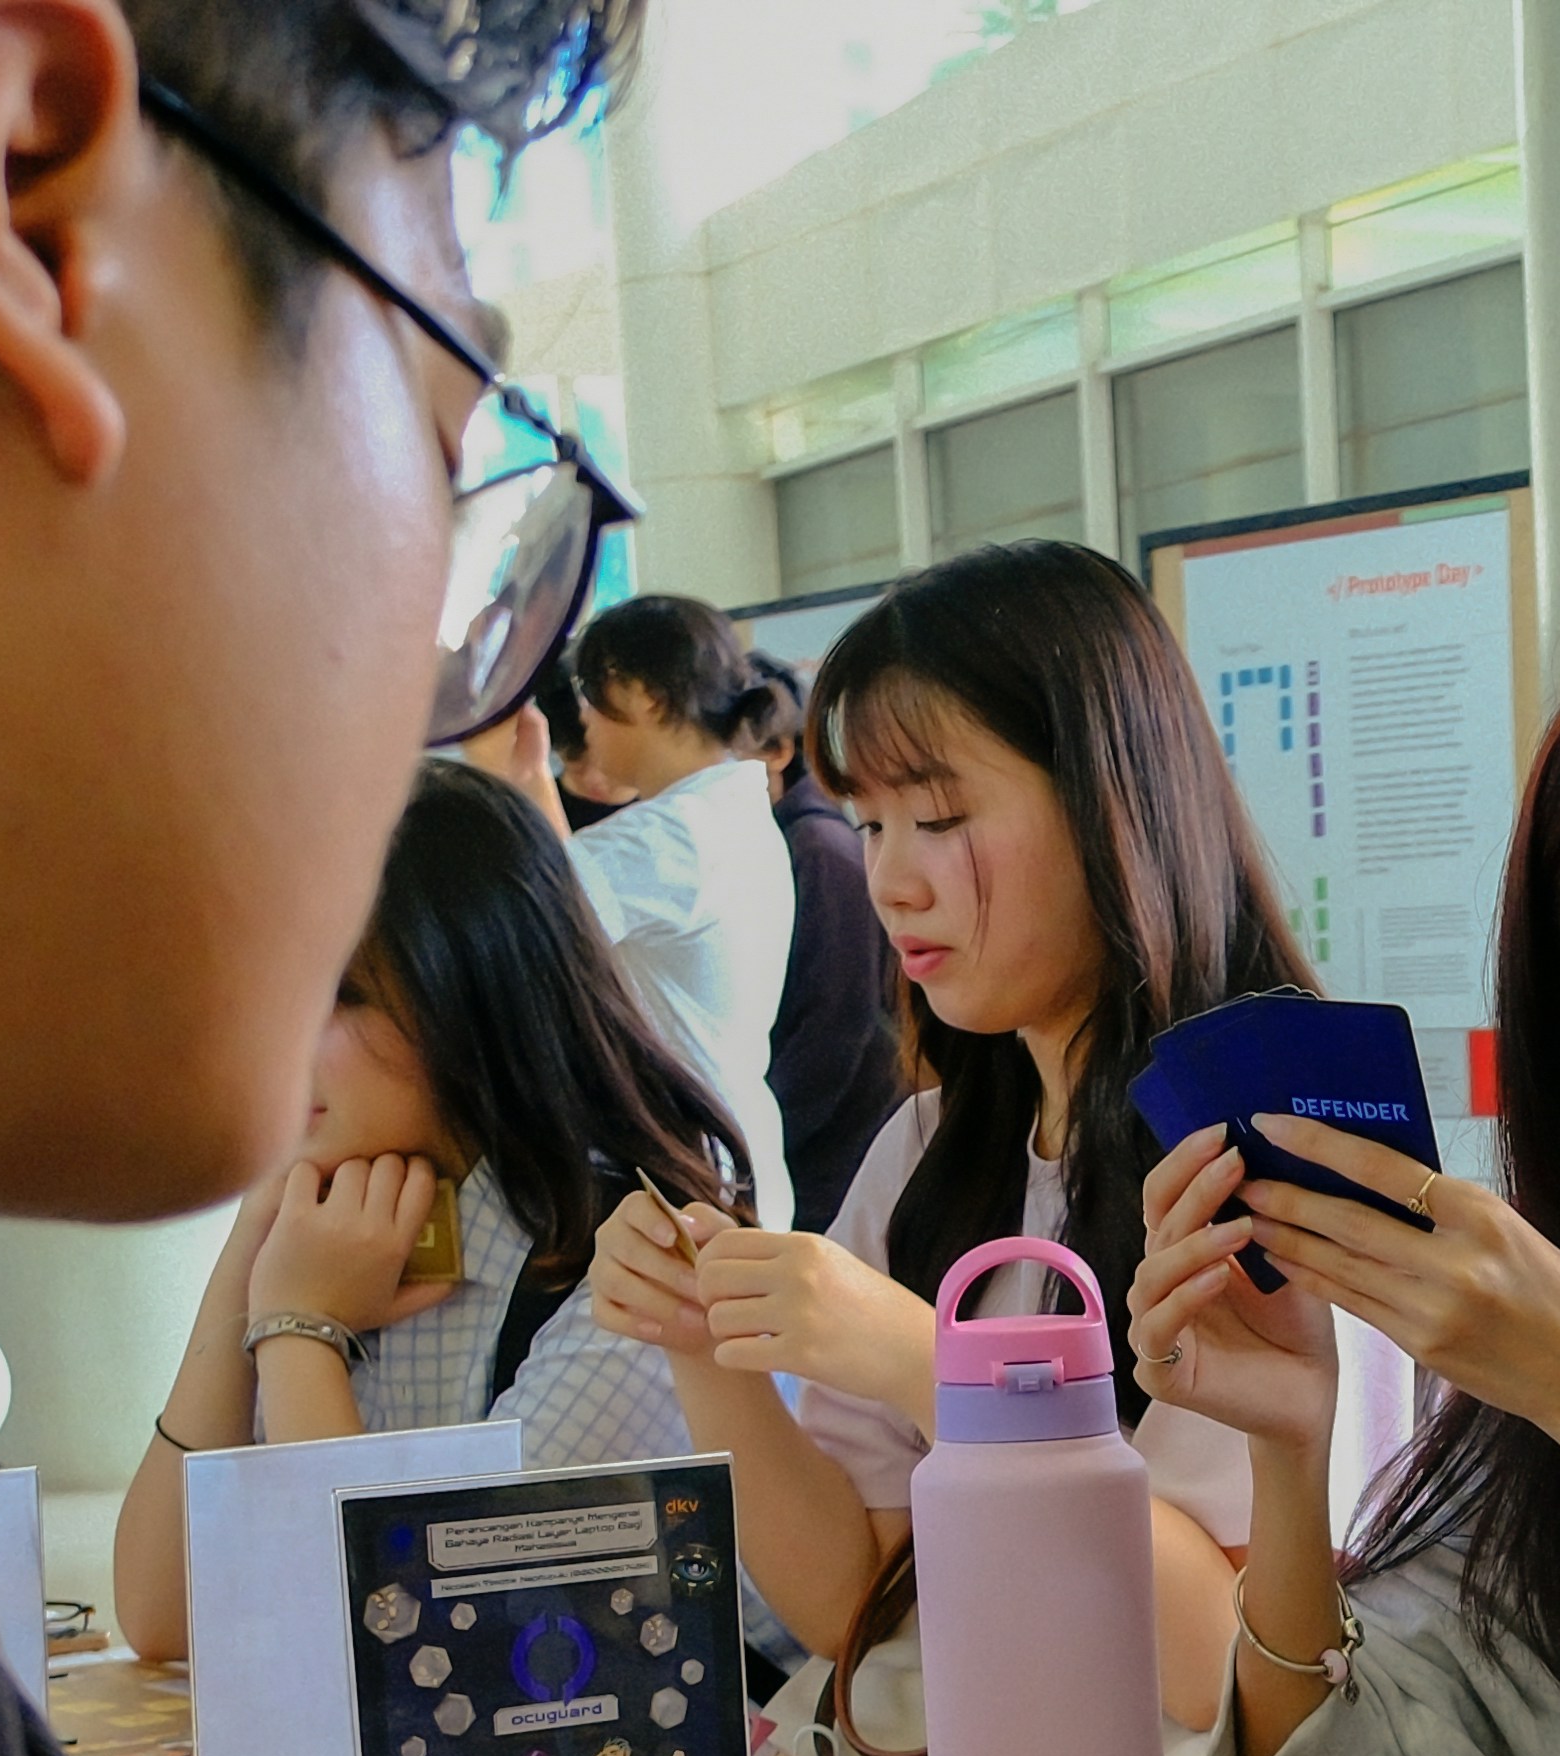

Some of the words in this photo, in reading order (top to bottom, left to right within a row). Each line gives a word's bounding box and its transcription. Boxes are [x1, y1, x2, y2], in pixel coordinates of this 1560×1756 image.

[1348, 571, 1432, 595] Prototype
[1436, 563, 1470, 588] Day
[1292, 1097, 1410, 1121] DEFENDER
[666, 1499, 699, 1514] dkv
[446, 1521, 523, 1536] Perancangan
[587, 1510, 641, 1522] Mengenai
[575, 1524, 615, 1536] Laptop
[511, 1702, 602, 1724] ocuguard
